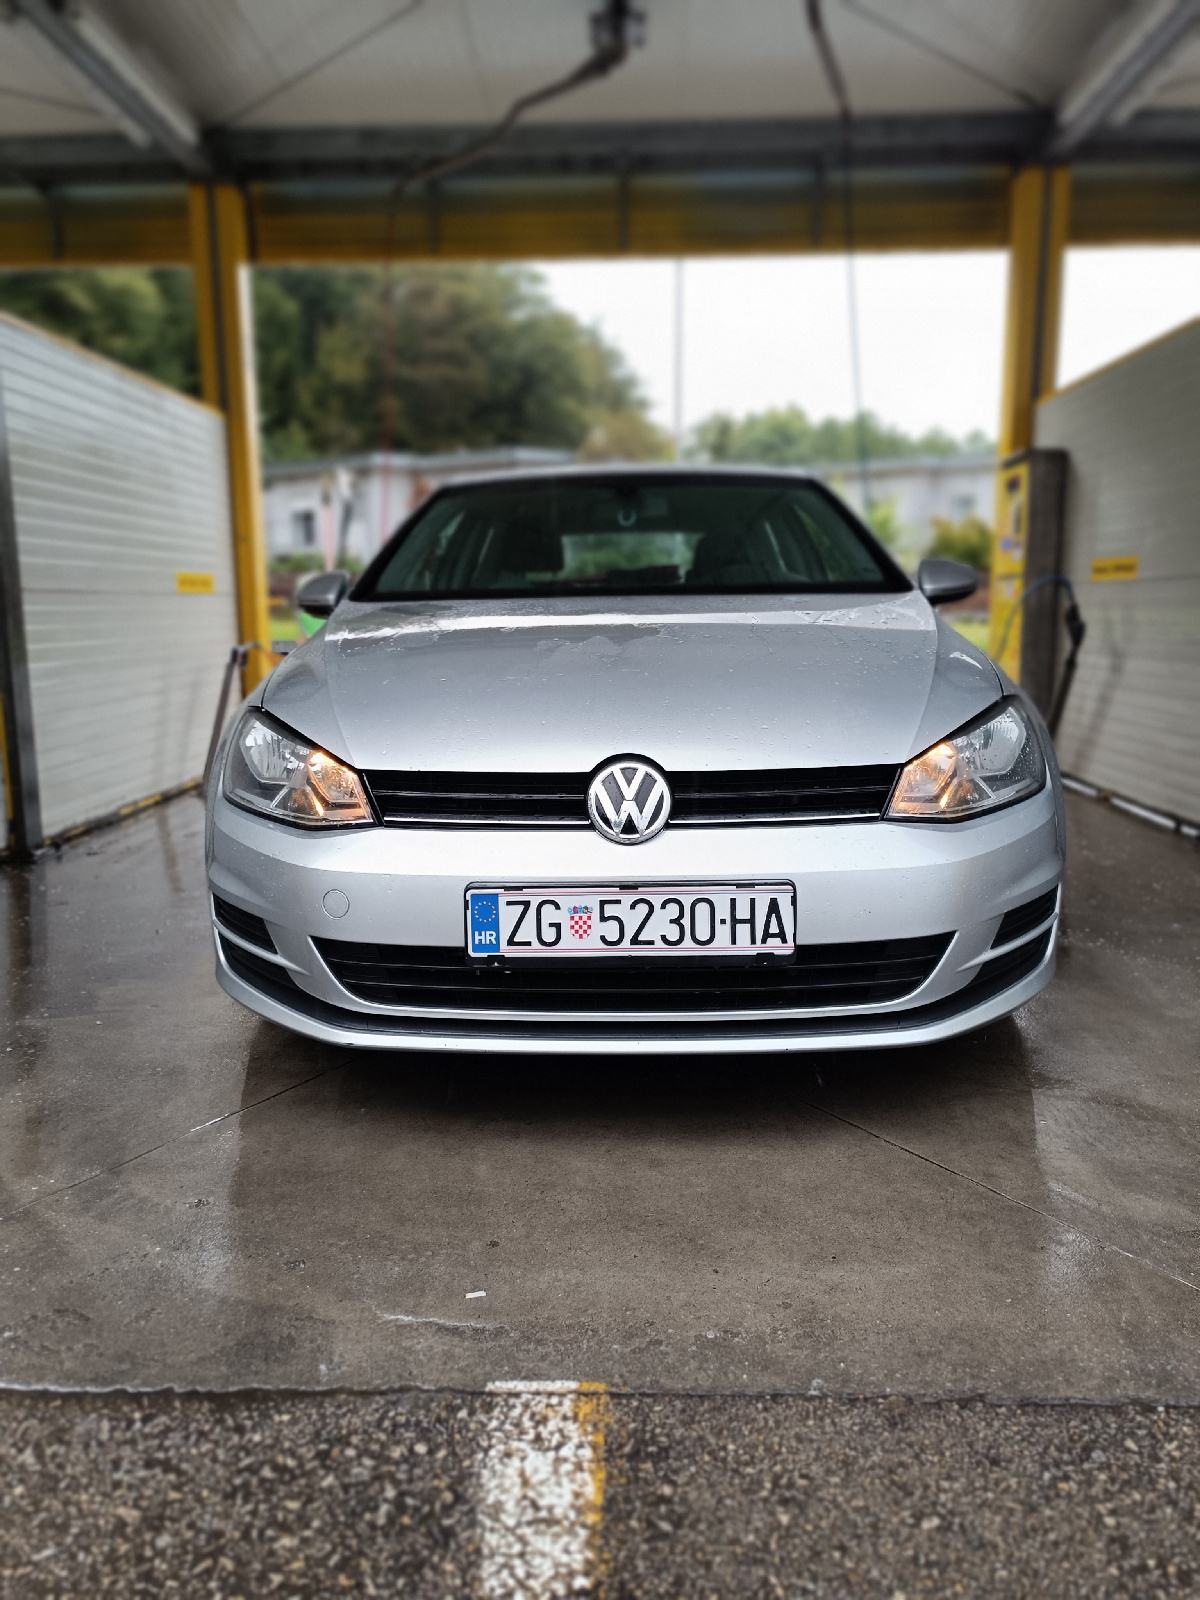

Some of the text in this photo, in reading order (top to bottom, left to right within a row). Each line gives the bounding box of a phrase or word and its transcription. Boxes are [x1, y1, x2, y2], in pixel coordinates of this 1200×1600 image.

[591, 764, 667, 836] VW
[474, 930, 497, 945] HR
[505, 899, 562, 947] ZG
